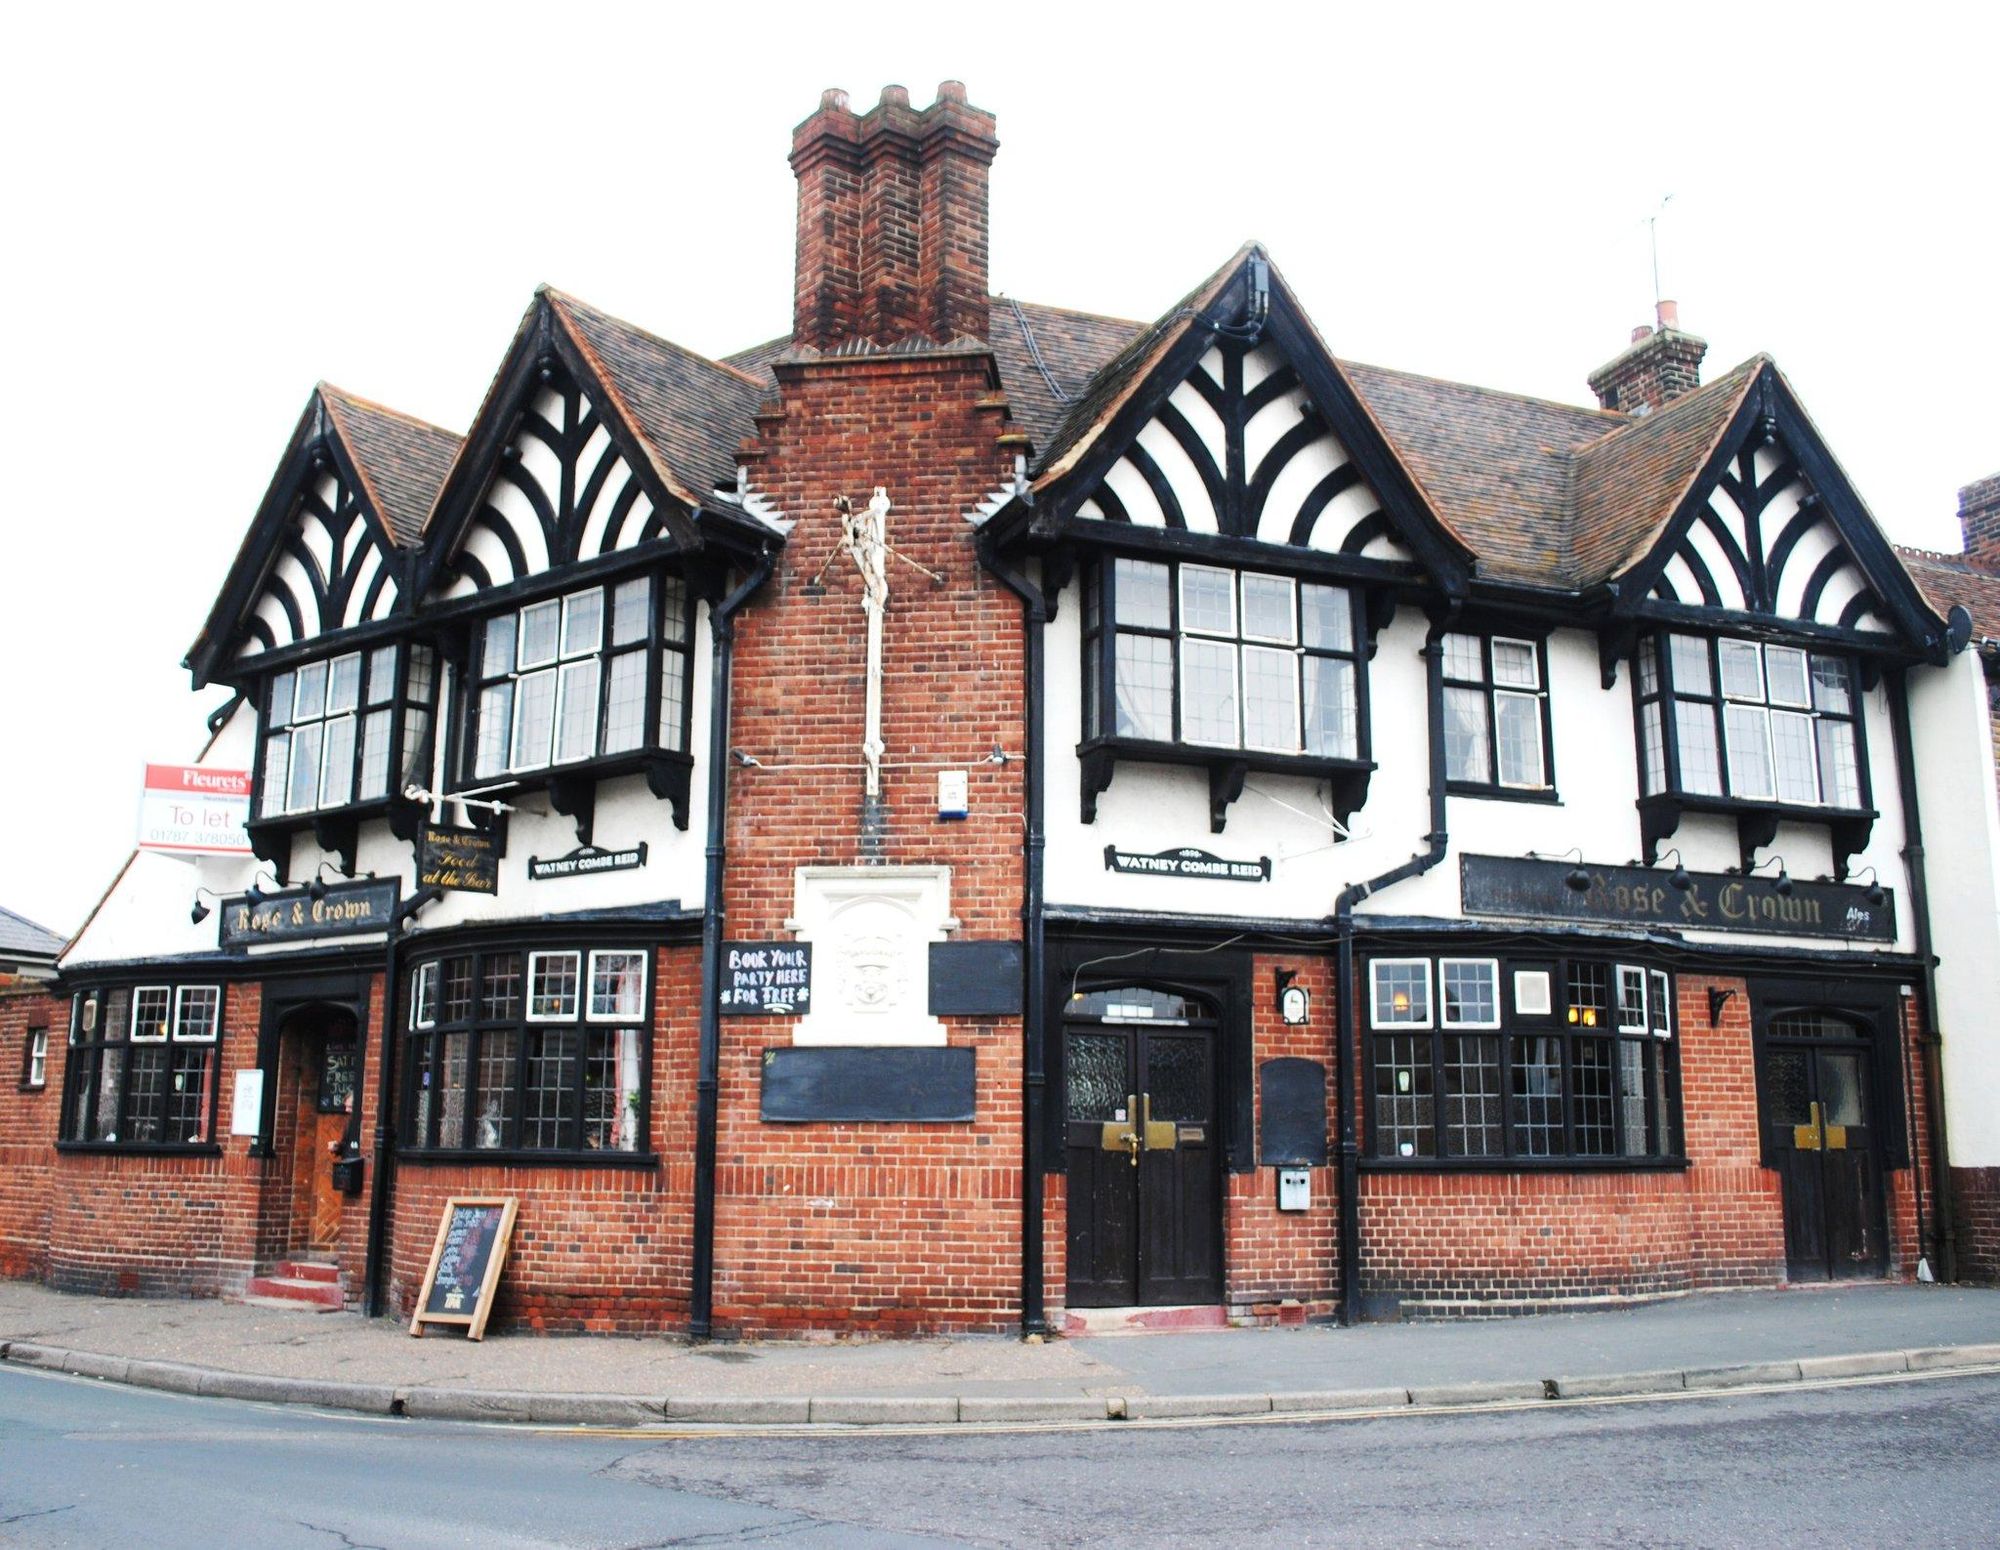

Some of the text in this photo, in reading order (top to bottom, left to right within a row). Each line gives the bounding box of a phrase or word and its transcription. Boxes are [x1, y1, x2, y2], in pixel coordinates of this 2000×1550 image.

[182, 769, 247, 789] Fleurets
[169, 805, 229, 828] To let
[439, 850, 479, 868] Food
[534, 852, 639, 875] WATNEY COMBE REID
[1115, 855, 1263, 878] WATNEY COMBE REID
[422, 870, 441, 884] at
[290, 901, 305, 926] &
[311, 898, 372, 924] Crown
[1679, 882, 1709, 917] &
[1717, 882, 1823, 925] Crown
[1846, 906, 1870, 921] Ales
[728, 948, 808, 970] BOOK YOUR
[733, 968, 808, 988] PARTY HERE
[733, 987, 759, 1005] FOR
